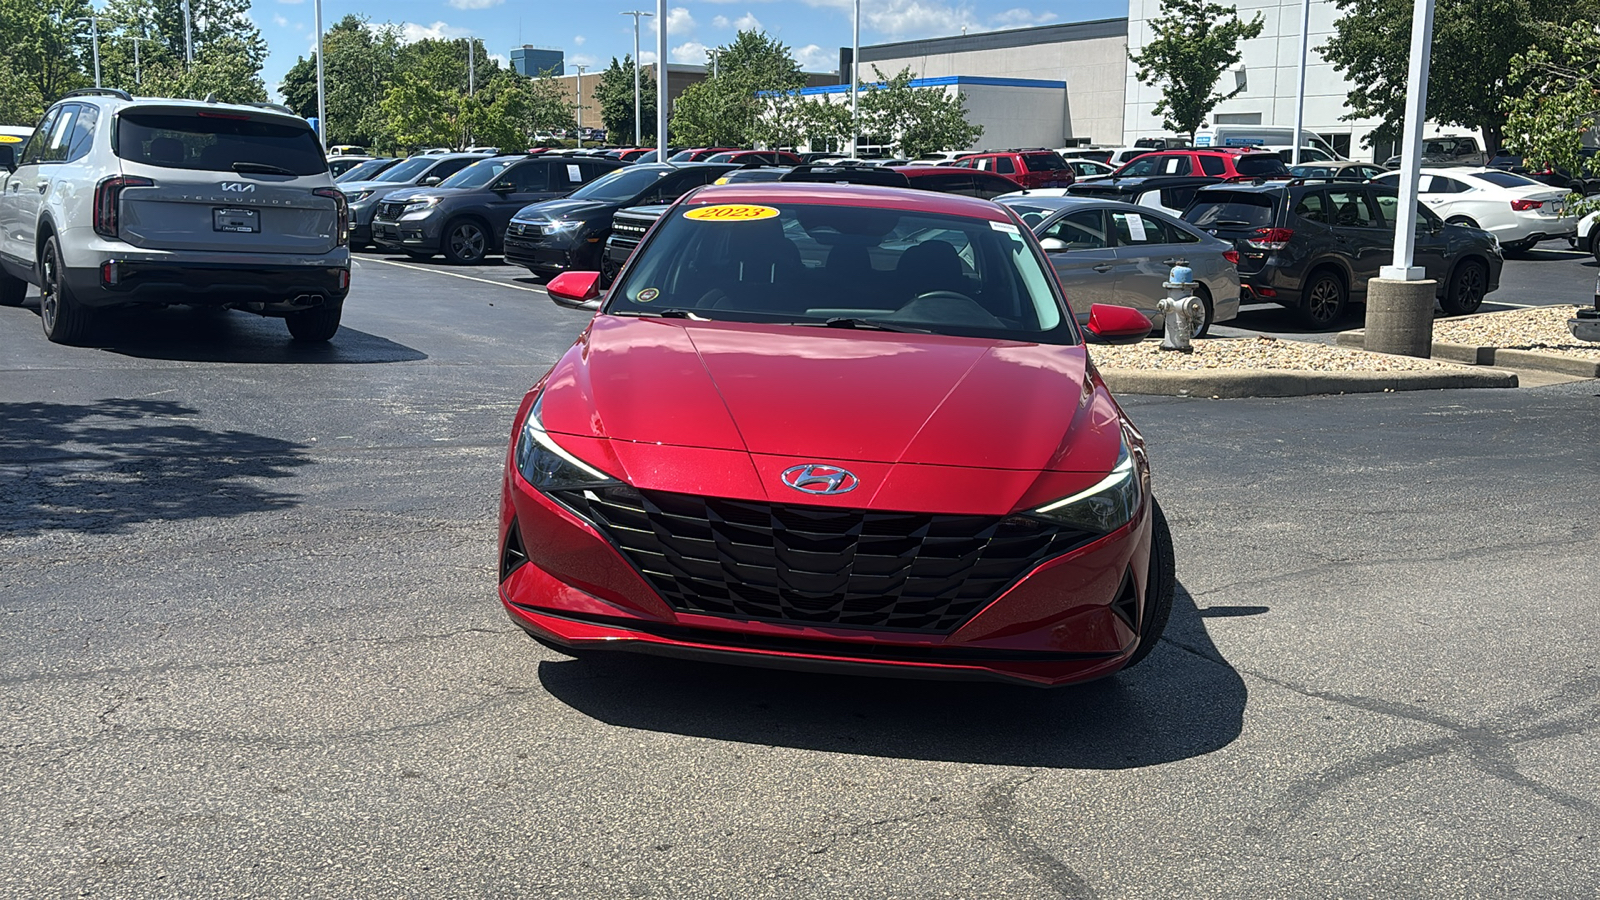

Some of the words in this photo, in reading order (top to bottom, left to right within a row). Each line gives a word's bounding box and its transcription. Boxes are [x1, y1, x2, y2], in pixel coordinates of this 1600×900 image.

[221, 182, 256, 193] KIA
[181, 194, 292, 205] TELLURIDE
[698, 207, 765, 218] 2023
